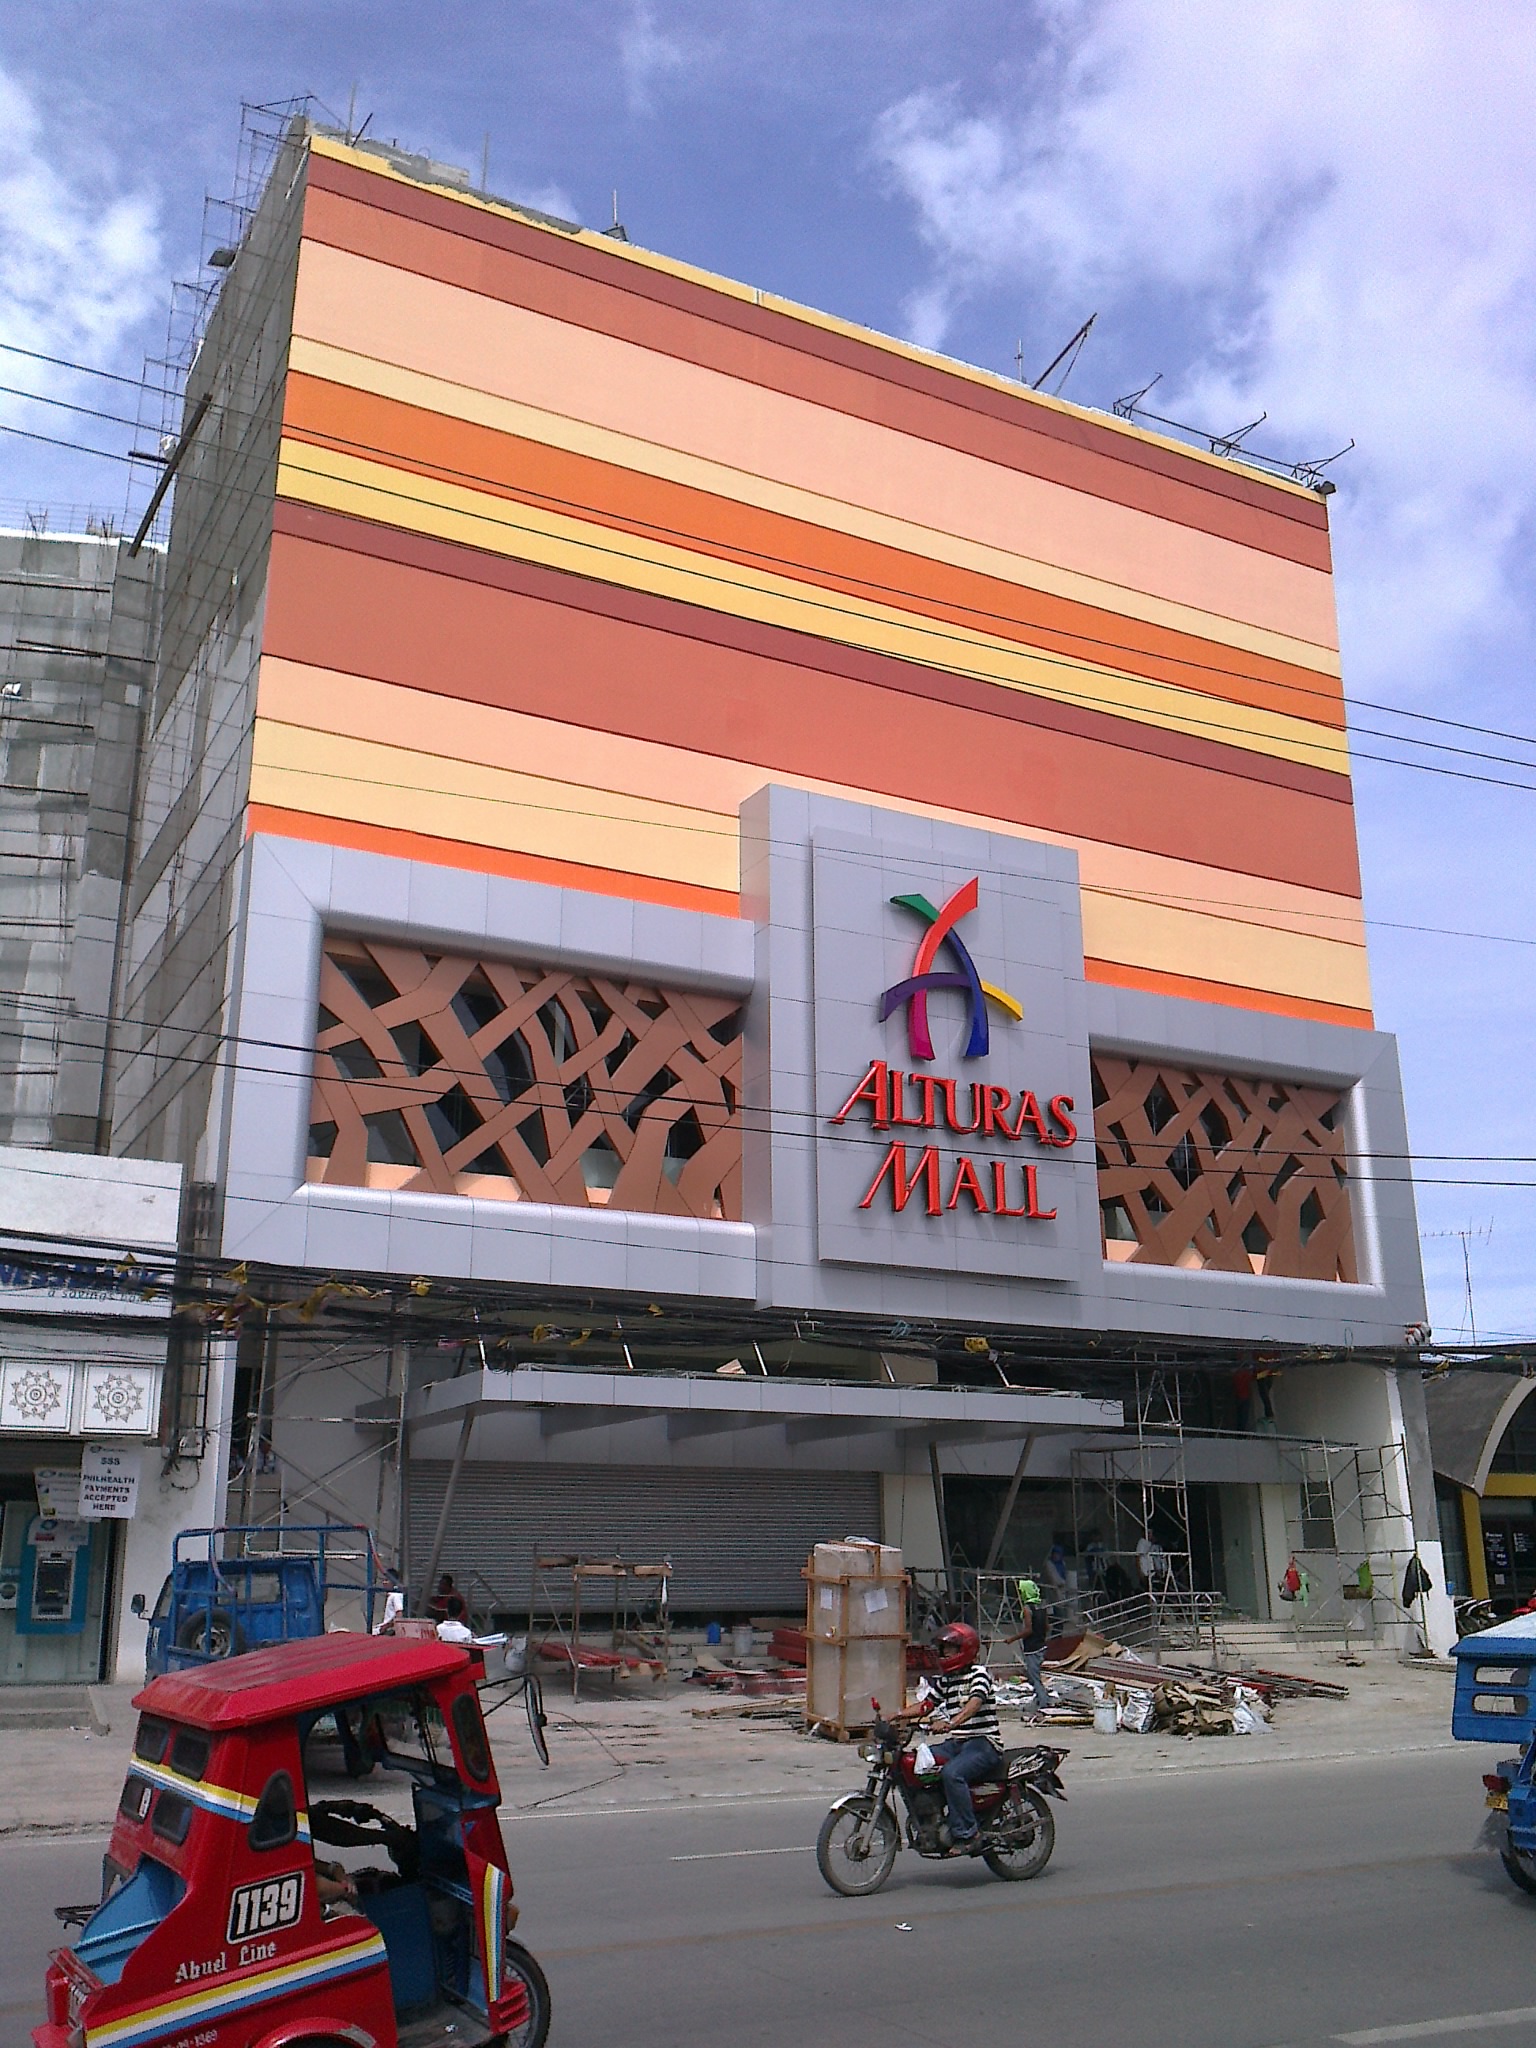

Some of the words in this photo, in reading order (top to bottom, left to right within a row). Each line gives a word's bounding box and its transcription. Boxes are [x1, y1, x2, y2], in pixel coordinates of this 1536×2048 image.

[828, 1059, 1078, 1148] ALTURAS
[858, 1140, 1057, 1220] MALL
[83, 1474, 135, 1485] PHILHEALTH
[84, 1484, 130, 1494] PAYMENTS
[83, 1494, 128, 1503] ACCEPTED
[92, 1503, 116, 1511] HERE
[236, 1879, 298, 1935] 1139
[175, 1952, 227, 1983] Abuel
[239, 1941, 277, 1966] Line
